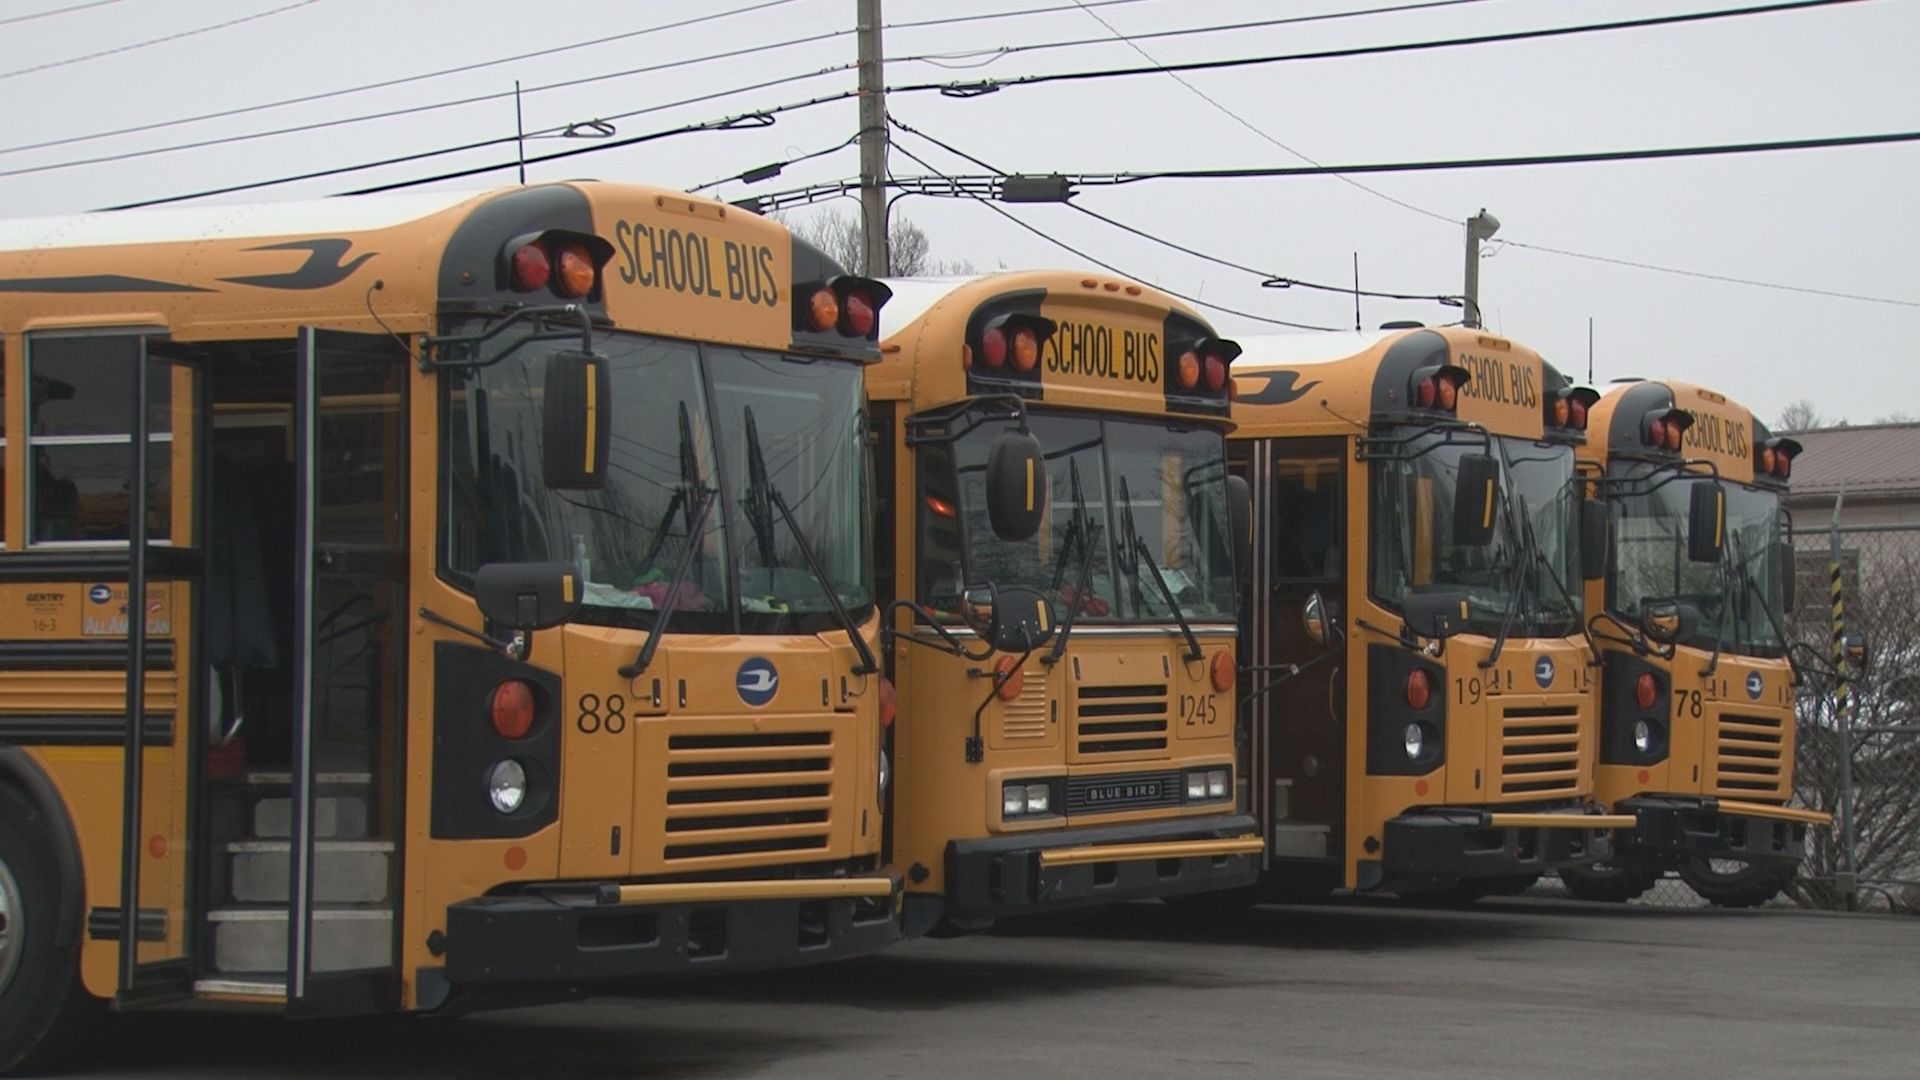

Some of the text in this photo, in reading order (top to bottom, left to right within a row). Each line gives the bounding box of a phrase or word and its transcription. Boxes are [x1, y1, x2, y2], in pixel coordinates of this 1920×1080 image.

[615, 219, 778, 307] SCHOOL BUS
[1047, 320, 1159, 384] SCHOOL BUS
[1459, 352, 1536, 409] SCHOOL BUS
[1725, 418, 1748, 460] BUS
[26, 592, 65, 602] GENTRY
[33, 617, 57, 632] 16-3
[1455, 676, 1481, 705] 19
[1674, 689, 1702, 719] 78
[577, 693, 626, 734] 88
[1090, 784, 1157, 800] BLUE BIRD
